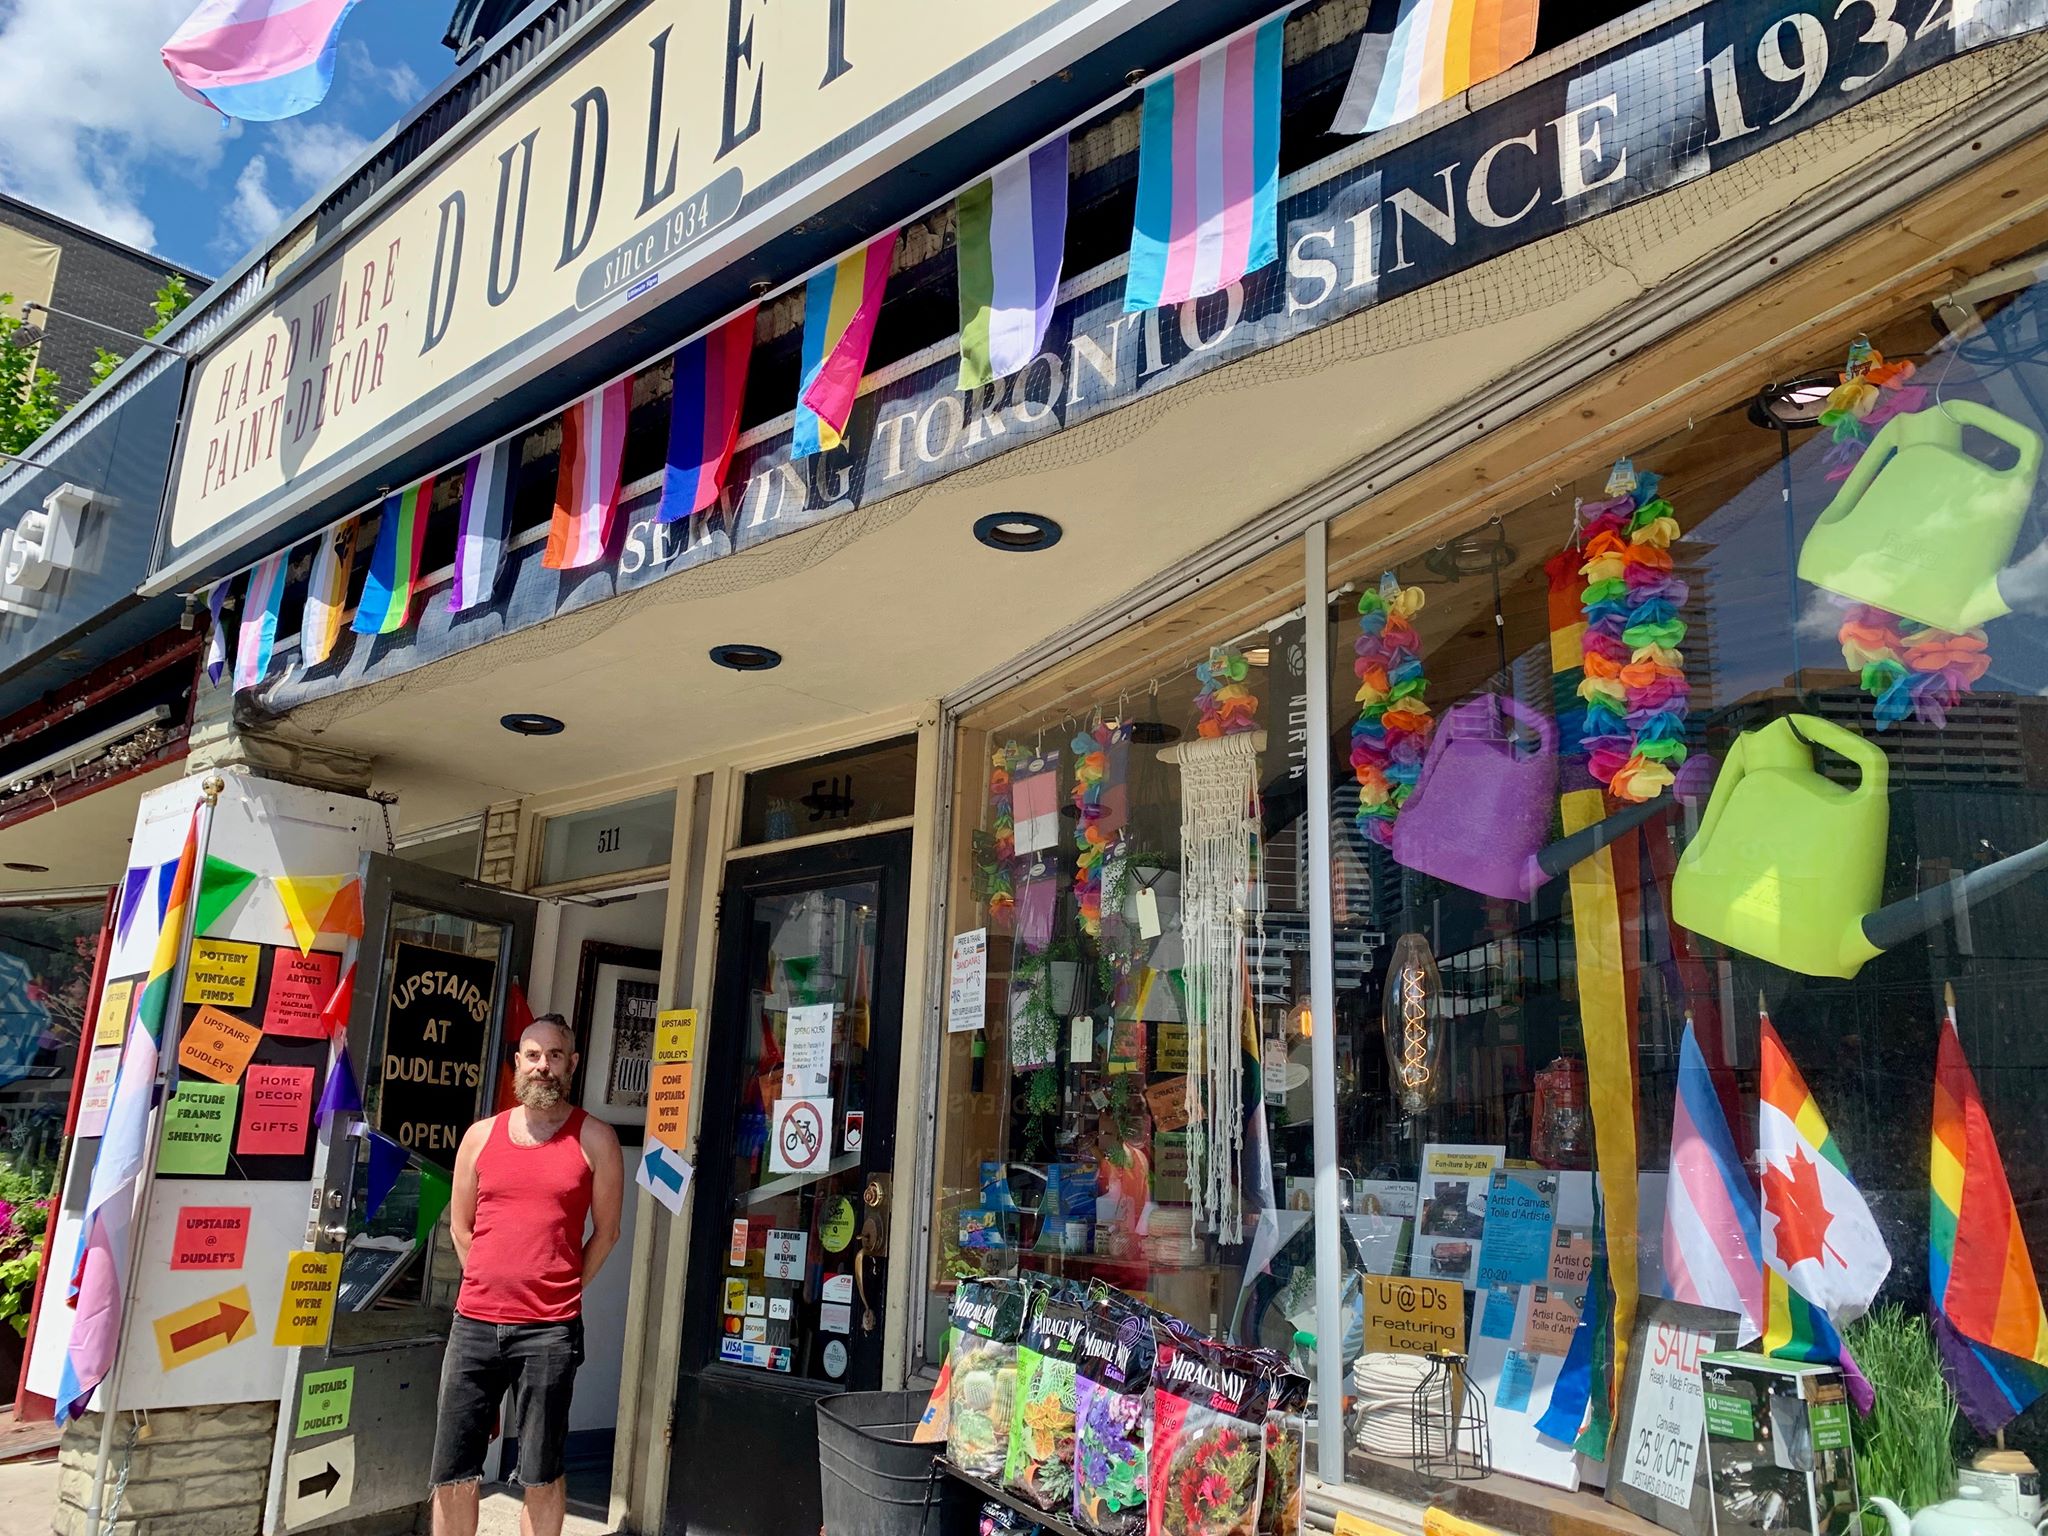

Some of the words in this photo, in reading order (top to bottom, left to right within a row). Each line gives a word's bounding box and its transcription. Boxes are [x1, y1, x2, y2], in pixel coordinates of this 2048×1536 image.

[1286, 93, 1628, 318] SINCE
[604, 234, 655, 291] since
[664, 192, 710, 254] 1934
[213, 236, 403, 426] HARDWARE
[597, 826, 621, 854] 511
[200, 950, 249, 964] POTTERY
[290, 960, 322, 972] LOCAL
[194, 972, 246, 987] VINTAGE
[286, 973, 322, 986] ARTISTS
[200, 989, 235, 1002] FINDS
[282, 991, 310, 1001] POTTERY
[392, 970, 490, 1023] UPSTAIRS
[202, 1015, 250, 1043] UPSTAIRS
[661, 1018, 692, 1028] UPSTAIRS
[423, 1018, 452, 1044] AT
[212, 1040, 225, 1052] @
[671, 1034, 679, 1045] @
[185, 1045, 235, 1074] DUDLEY'S
[658, 1050, 688, 1060] DUDLEY'S
[385, 1054, 480, 1088] DUDLEY'S
[260, 1075, 301, 1088] HOME
[661, 1074, 682, 1085] COME
[178, 1092, 226, 1105] PICTURE
[255, 1089, 303, 1101] DECOR
[655, 1090, 686, 1101] UPSTAIRS
[176, 1108, 222, 1121] FRAMES
[659, 1106, 679, 1117] WE'RE
[250, 1121, 299, 1133] GIFTS
[657, 1122, 677, 1133] OPEN
[167, 1131, 223, 1144] SHELVING
[399, 1121, 457, 1149] OPEN
[1464, 1160, 1473, 1170] by
[1474, 1161, 1488, 1169] JEN
[1490, 1194, 1515, 1206] Artist
[1517, 1196, 1551, 1209] Canvas
[1490, 1207, 1510, 1218] Toile
[1511, 1208, 1551, 1222] d'Artiste
[186, 1218, 241, 1230] UPSTAIRS
[204, 1235, 217, 1247] @
[773, 1231, 781, 1239] NO
[782, 1232, 801, 1241] SMOKING
[180, 1252, 236, 1264] DUDLEY'S
[1553, 1254, 1580, 1266] Artist
[301, 1262, 328, 1275] COME
[1553, 1267, 1575, 1280] Toile
[291, 1280, 332, 1293] UPSTAIRS
[295, 1297, 322, 1309] WE'RE
[778, 1304, 788, 1315] Pay
[292, 1314, 318, 1327] OPEN
[1531, 1308, 1554, 1320] Artist
[1372, 1315, 1456, 1340] Featuring
[1531, 1320, 1549, 1331] Toile
[725, 1340, 743, 1354] VISA
[1389, 1334, 1438, 1352] Local
[1653, 1320, 1712, 1376] SALE
[1115, 1339, 1132, 1375] MIX
[1166, 1352, 1221, 1392] MIRACLE
[1220, 1368, 1248, 1405] MIX
[308, 1379, 348, 1395] UPSTAIRS
[321, 1399, 331, 1410] @
[1707, 1396, 1718, 1410] 10
[303, 1414, 344, 1431] DUDLEY'S
[1655, 1413, 1681, 1436] Canvases
[1635, 1427, 1653, 1467] 25
[1652, 1432, 1665, 1474] %
[1665, 1437, 1694, 1482] OFF
